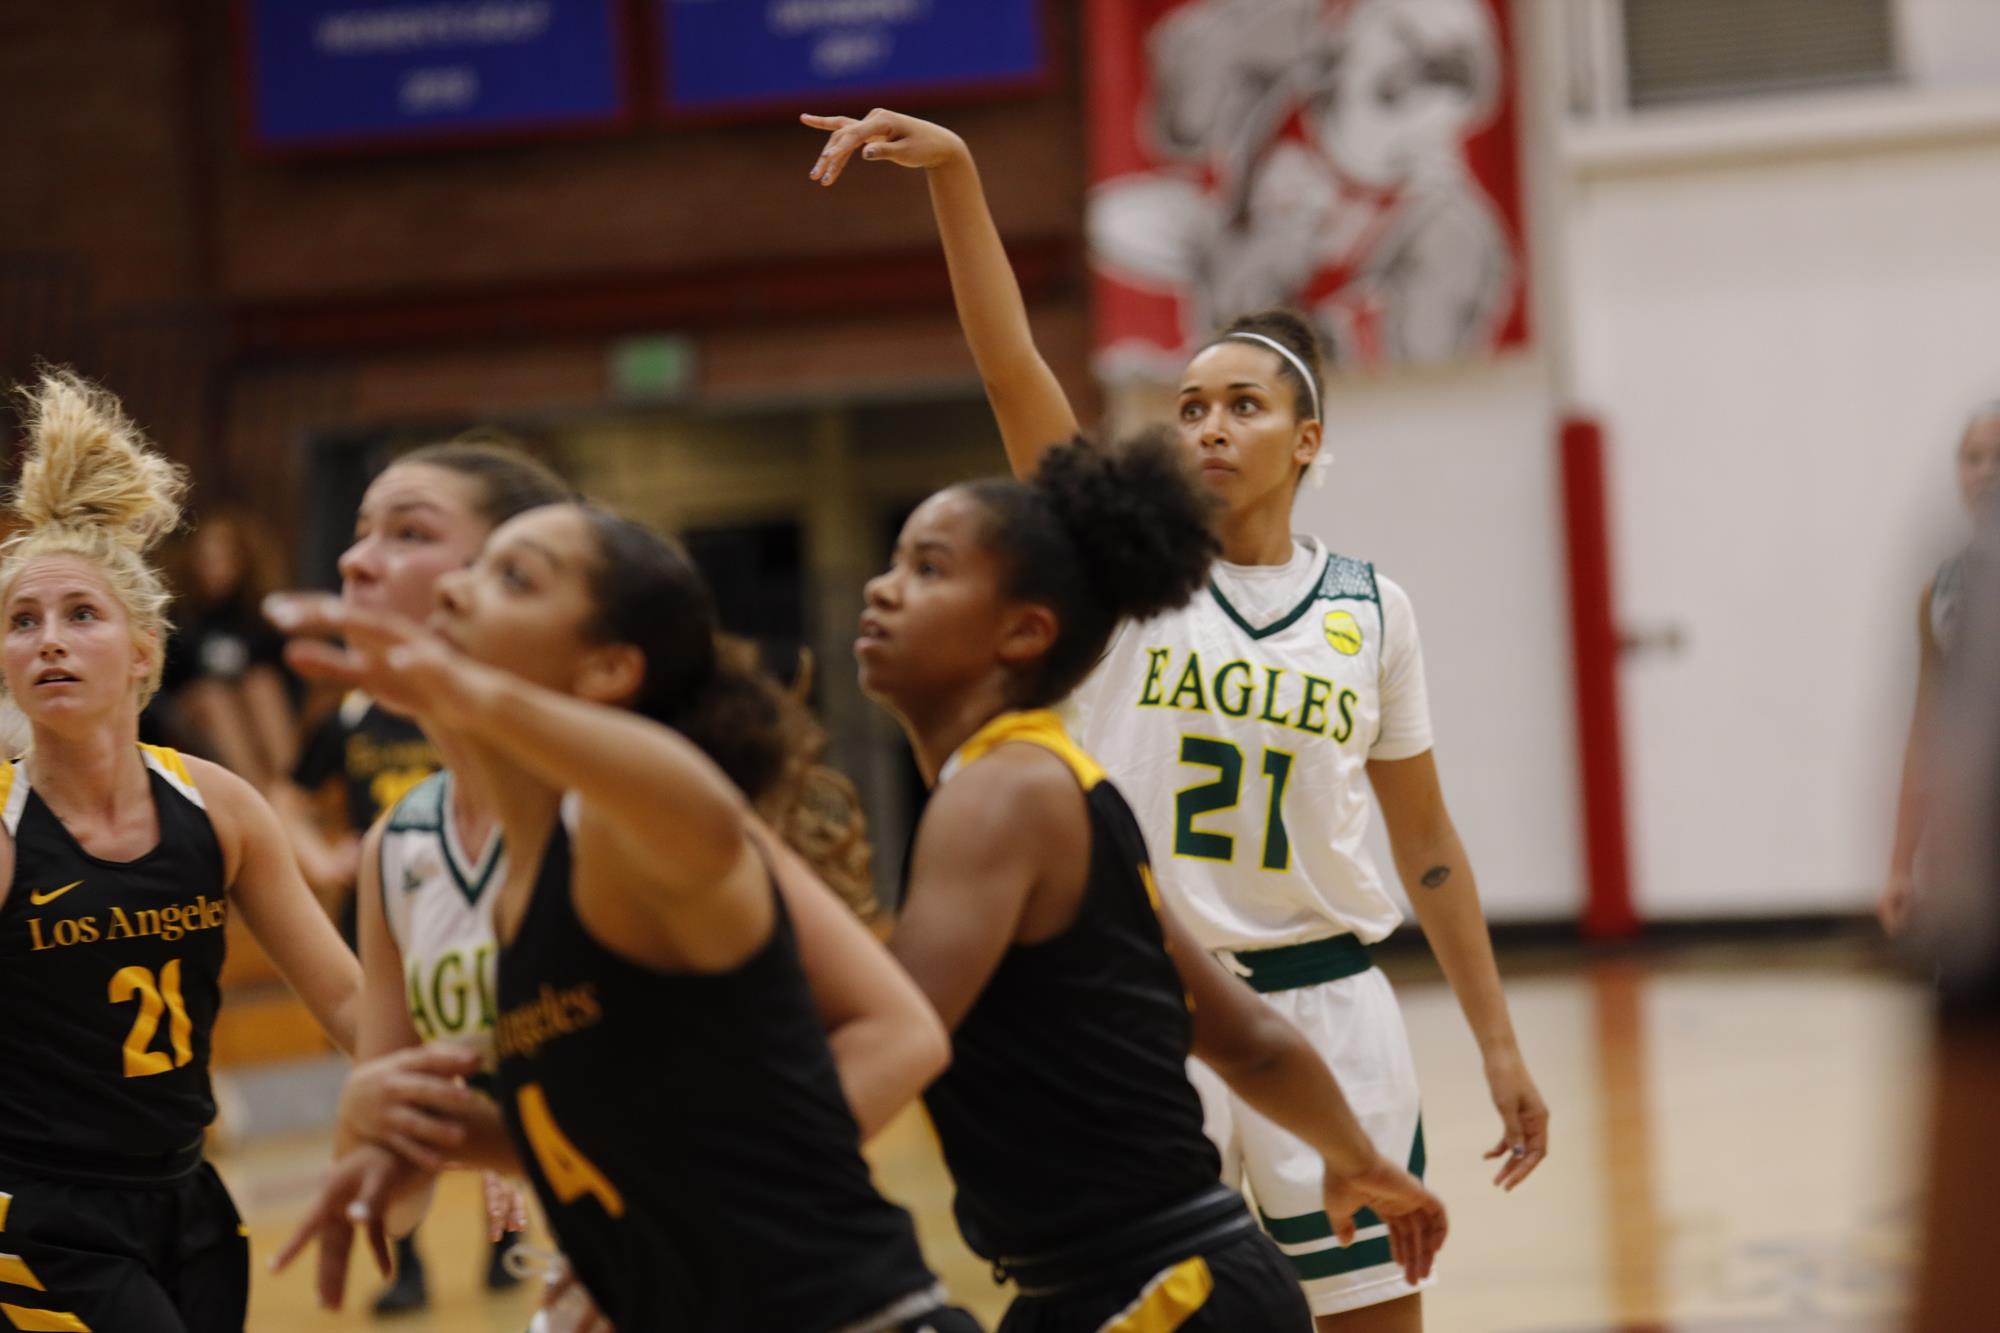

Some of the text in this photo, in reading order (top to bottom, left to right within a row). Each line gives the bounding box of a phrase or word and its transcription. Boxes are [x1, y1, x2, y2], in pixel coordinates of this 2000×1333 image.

[1137, 646, 1359, 744] EAGLES
[1172, 732, 1296, 874] 21
[26, 915, 101, 950] Los
[107, 958, 194, 1078] 21
[496, 982, 602, 1055] ngeles
